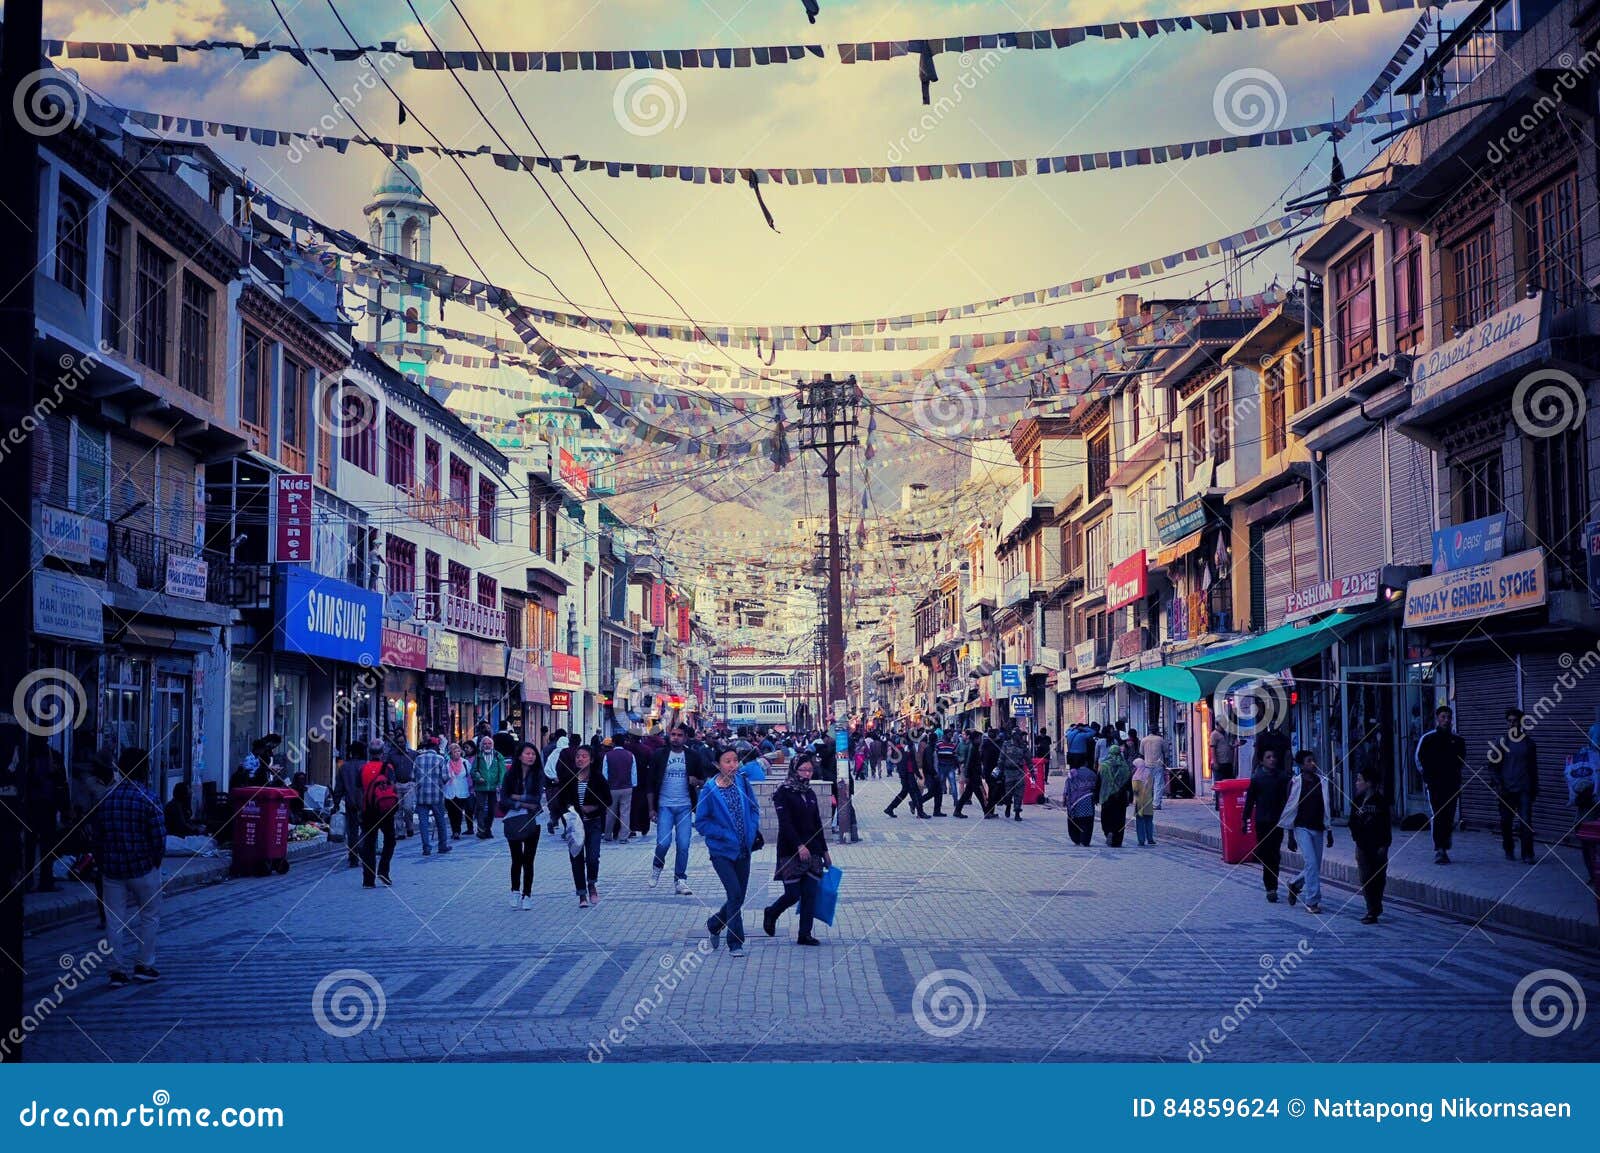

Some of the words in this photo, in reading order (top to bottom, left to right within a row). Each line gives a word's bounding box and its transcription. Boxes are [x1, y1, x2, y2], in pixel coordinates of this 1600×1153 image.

[1429, 335, 1474, 372] Desert
[1479, 311, 1524, 346] Rain
[280, 479, 310, 490] Kids
[49, 513, 80, 545] Ladakh
[1462, 532, 1482, 552] pepsi
[1287, 583, 1333, 613] FASHION
[1341, 571, 1377, 596] ZONE
[1408, 588, 1449, 616] SINGAY
[1451, 580, 1496, 608] GENERAL
[1499, 569, 1537, 599] STORE
[61, 604, 86, 621] WATCH
[307, 589, 366, 642] SAMSUNG
[1012, 696, 1032, 705] ATM
